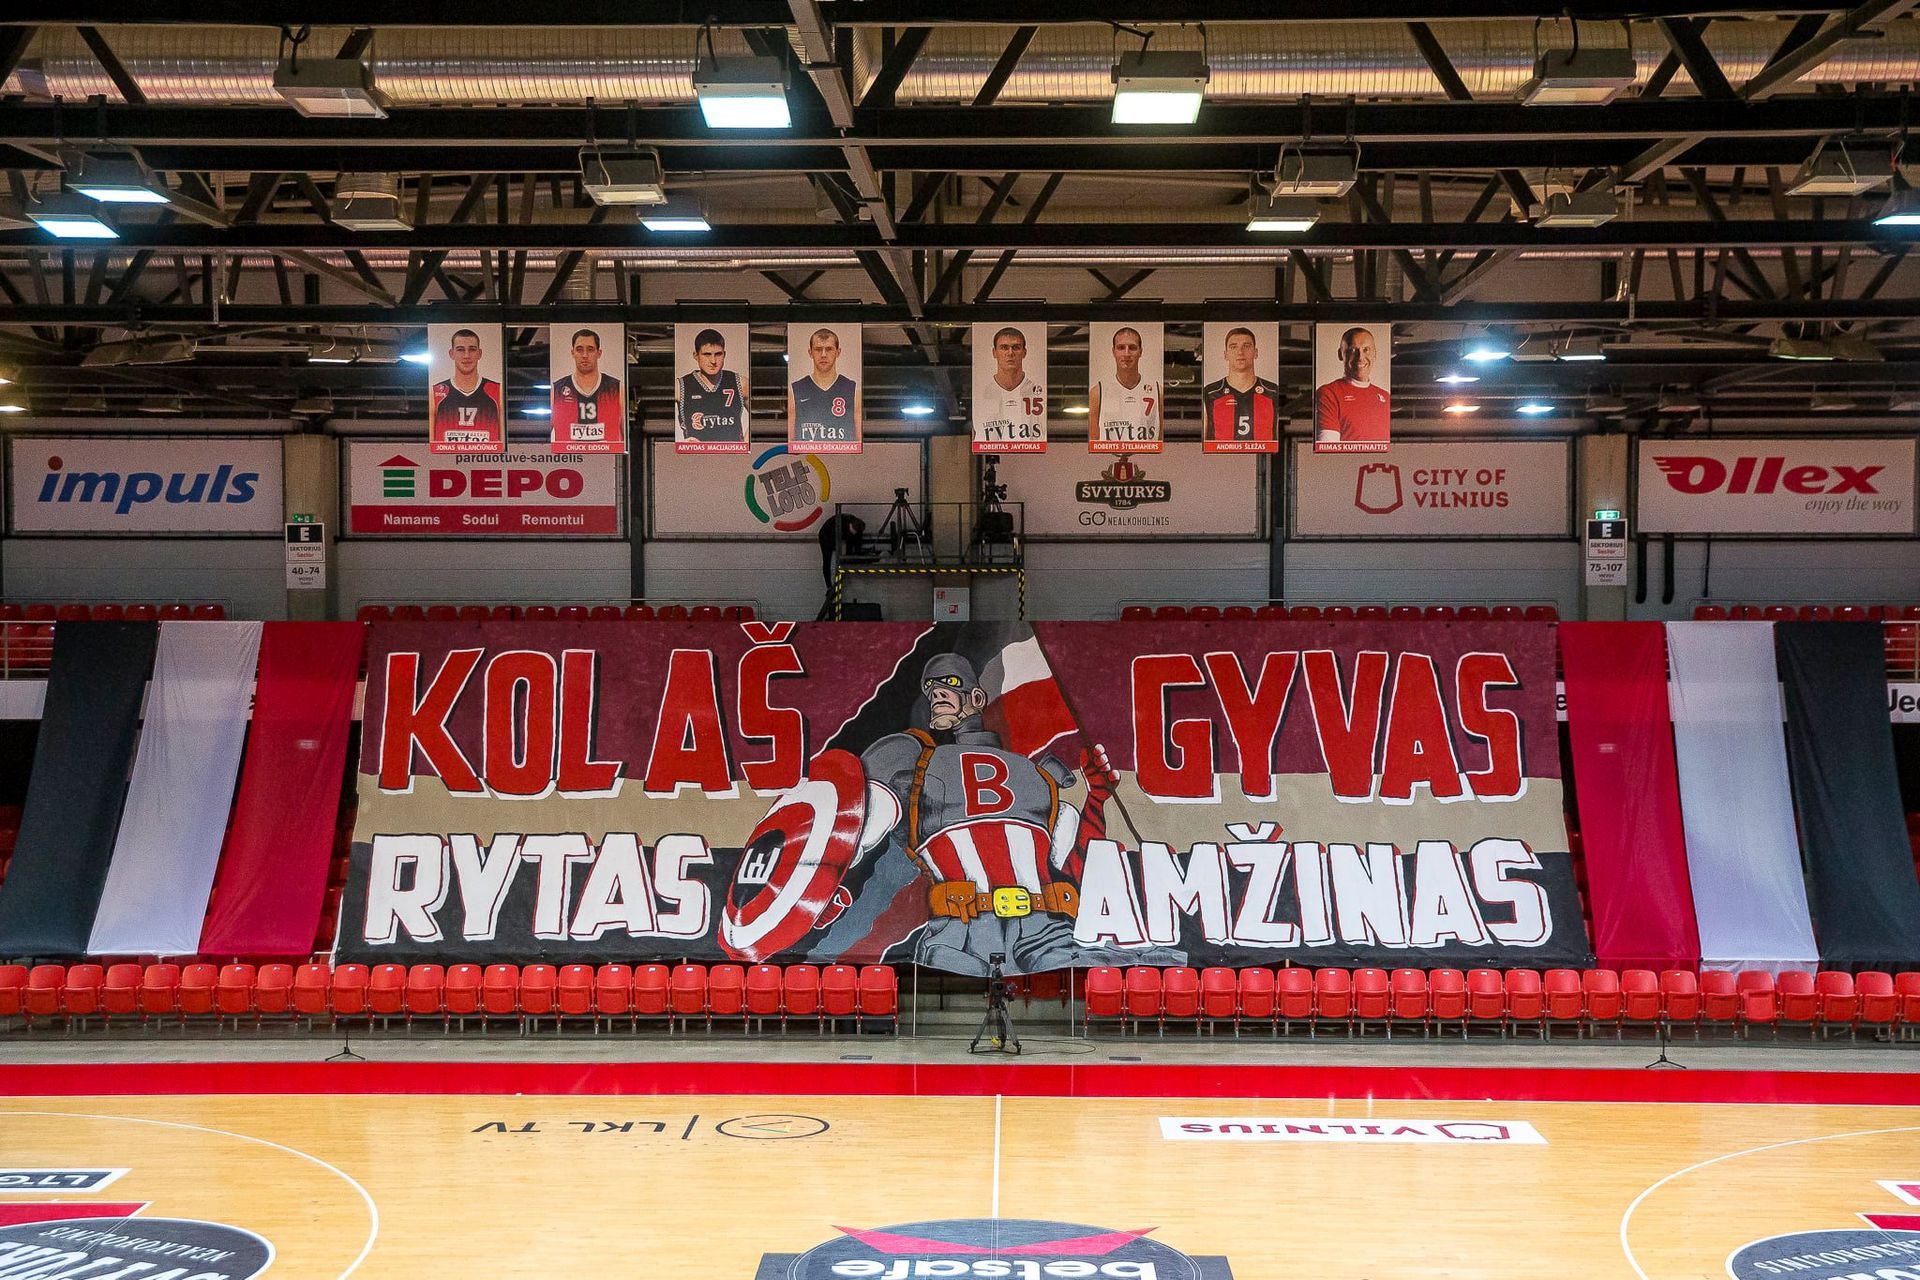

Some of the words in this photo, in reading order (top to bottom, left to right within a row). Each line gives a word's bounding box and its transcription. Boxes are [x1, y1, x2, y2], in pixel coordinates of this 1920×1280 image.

[723, 389, 734, 407] 7
[831, 397, 846, 417] 8
[1023, 397, 1044, 416] 15
[1143, 397, 1154, 416] 7
[458, 407, 478, 427] 17
[578, 402, 597, 420] 13
[703, 415, 735, 429] rytas
[984, 422, 1042, 441] rytas
[1237, 415, 1251, 436] 5
[572, 425, 604, 439] rytas
[801, 425, 846, 442] rytas
[1105, 424, 1156, 441] rytas
[37, 455, 259, 515] impuls
[429, 468, 584, 499] DEPO
[1412, 468, 1469, 487] CITY
[1475, 468, 1506, 487] OF
[1651, 456, 1887, 495] Ollex
[767, 482, 816, 518] LOTO
[1081, 483, 1165, 498] ŠVYTURYS
[1412, 491, 1509, 509] VILNIUS
[1804, 497, 1844, 515] enjoy
[1845, 495, 1869, 512] the
[1871, 499, 1902, 516] way
[383, 514, 441, 525] Namams
[462, 514, 499, 525] Sodui
[521, 514, 584, 525] Remontui
[1078, 511, 1106, 526] GO
[1107, 516, 1170, 526] NEALKOHOLINIS
[300, 527, 310, 542] E
[1602, 522, 1612, 538] E
[291, 566, 320, 575] 40-74
[1590, 563, 1623, 572] 75-107
[1131, 650, 1529, 806] GYVAS
[959, 751, 1016, 818] B
[362, 832, 715, 945] RYTAS
[1072, 820, 1554, 949] AMŽINAS
[471, 1121, 542, 1133] TV
[568, 1121, 667, 1133] LKL
[1179, 1123, 1429, 1136] VILNIUS
[38, 1226, 236, 1263] NEALKOHOLINIS
[831, 1258, 1158, 1280] betsafe
